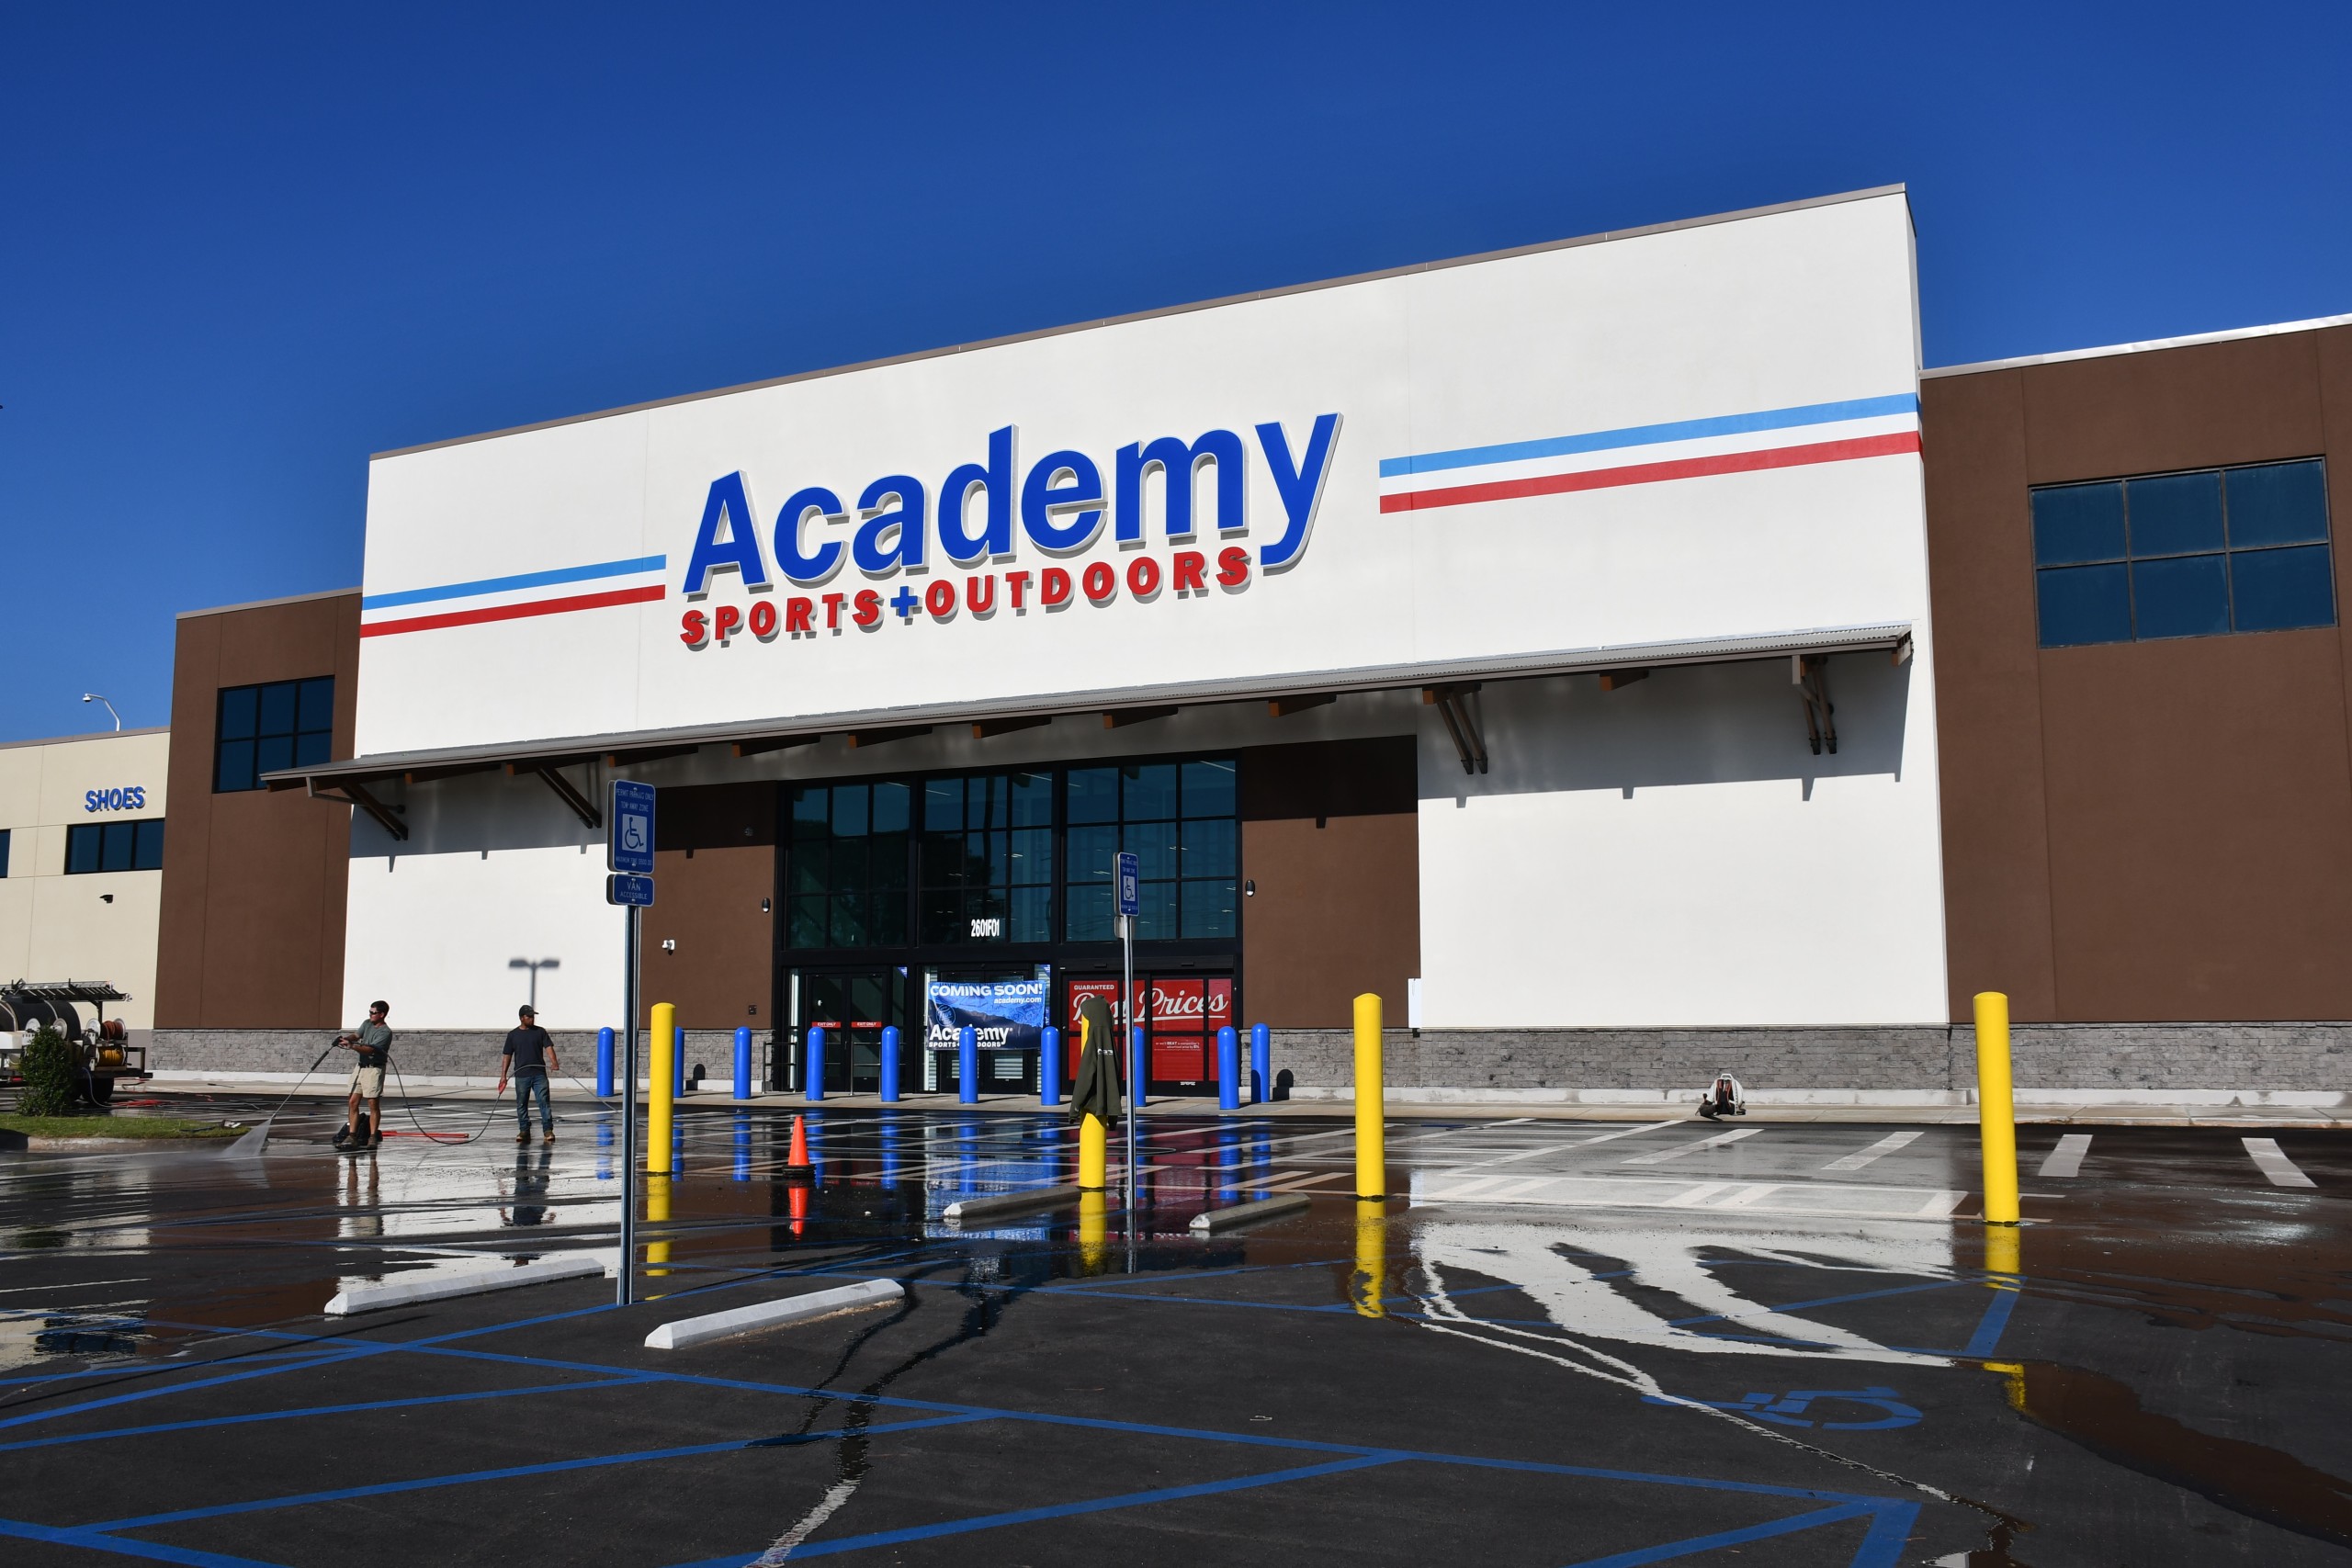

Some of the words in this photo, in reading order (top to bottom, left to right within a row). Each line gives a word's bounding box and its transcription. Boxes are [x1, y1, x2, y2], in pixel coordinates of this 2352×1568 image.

[682, 412, 1343, 596] Academy
[85, 786, 145, 812] SHOES
[620, 891, 648, 900] ACCESSIBLE
[627, 882, 641, 891] VAN
[930, 985, 992, 997] COMING
[994, 984, 1043, 996] SOON!
[1138, 987, 1228, 1020] Prices
[929, 1023, 1010, 1045] Acaemy
